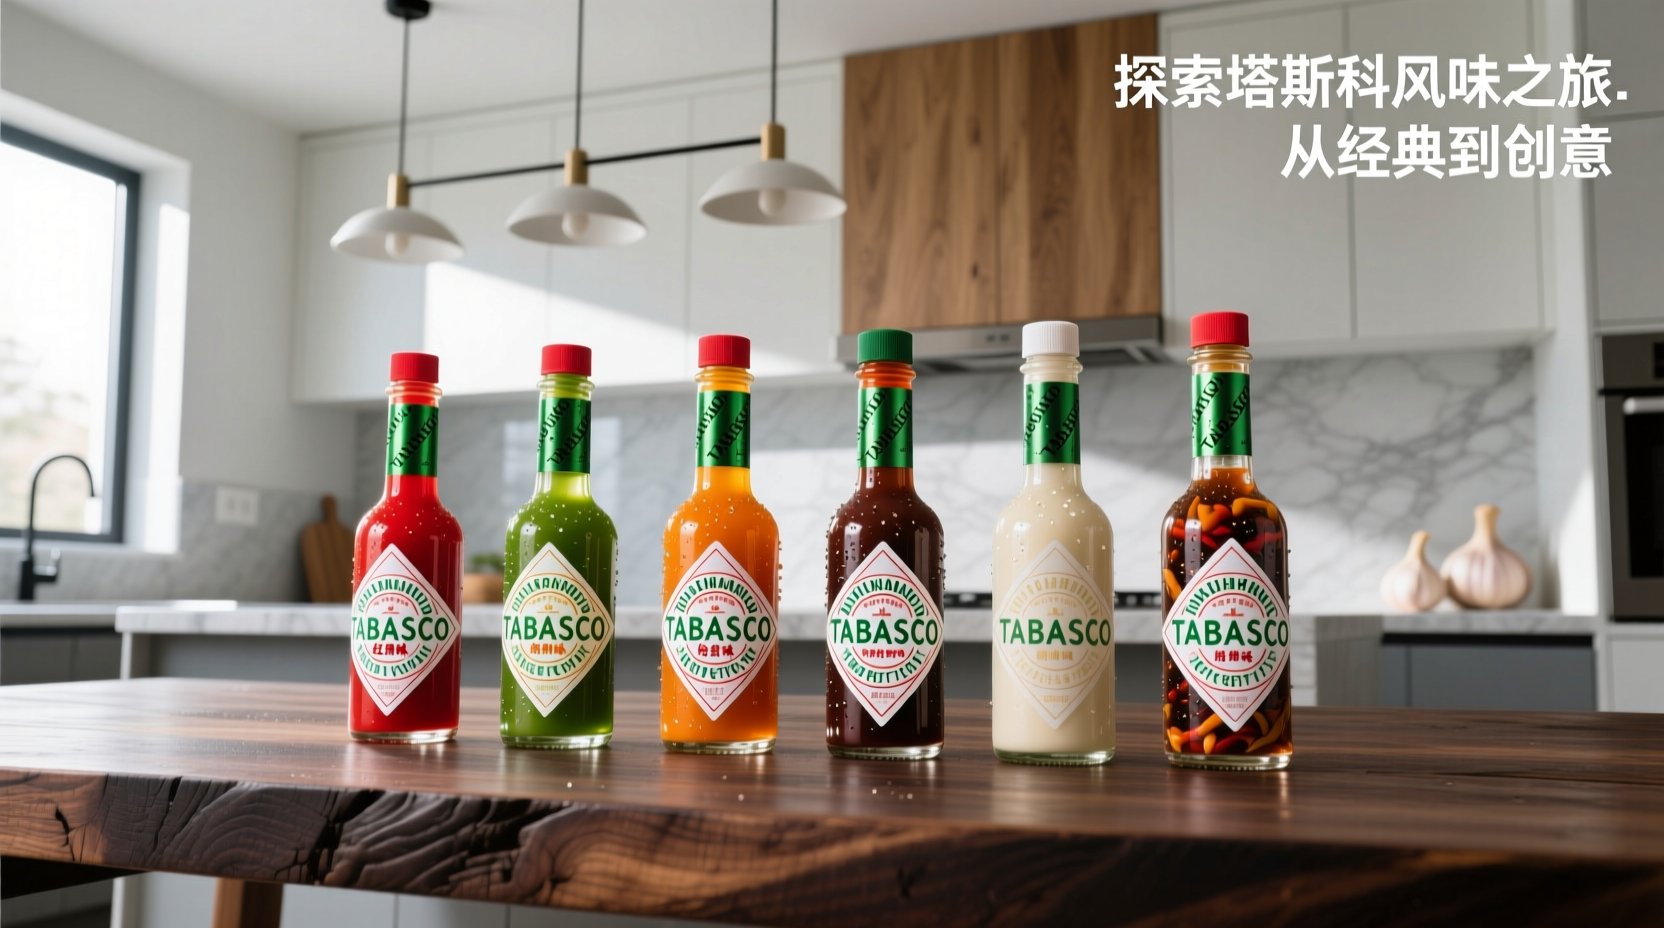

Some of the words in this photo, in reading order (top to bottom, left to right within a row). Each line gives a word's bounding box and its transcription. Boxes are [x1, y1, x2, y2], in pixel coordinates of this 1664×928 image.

[352, 617, 449, 641] TABASCO
[504, 616, 604, 641] TABASCO
[665, 616, 771, 642] TABASCO
[830, 619, 938, 645] TABASCO
[1000, 618, 1111, 646] TABASCO
[1172, 619, 1288, 647] TABASCO
